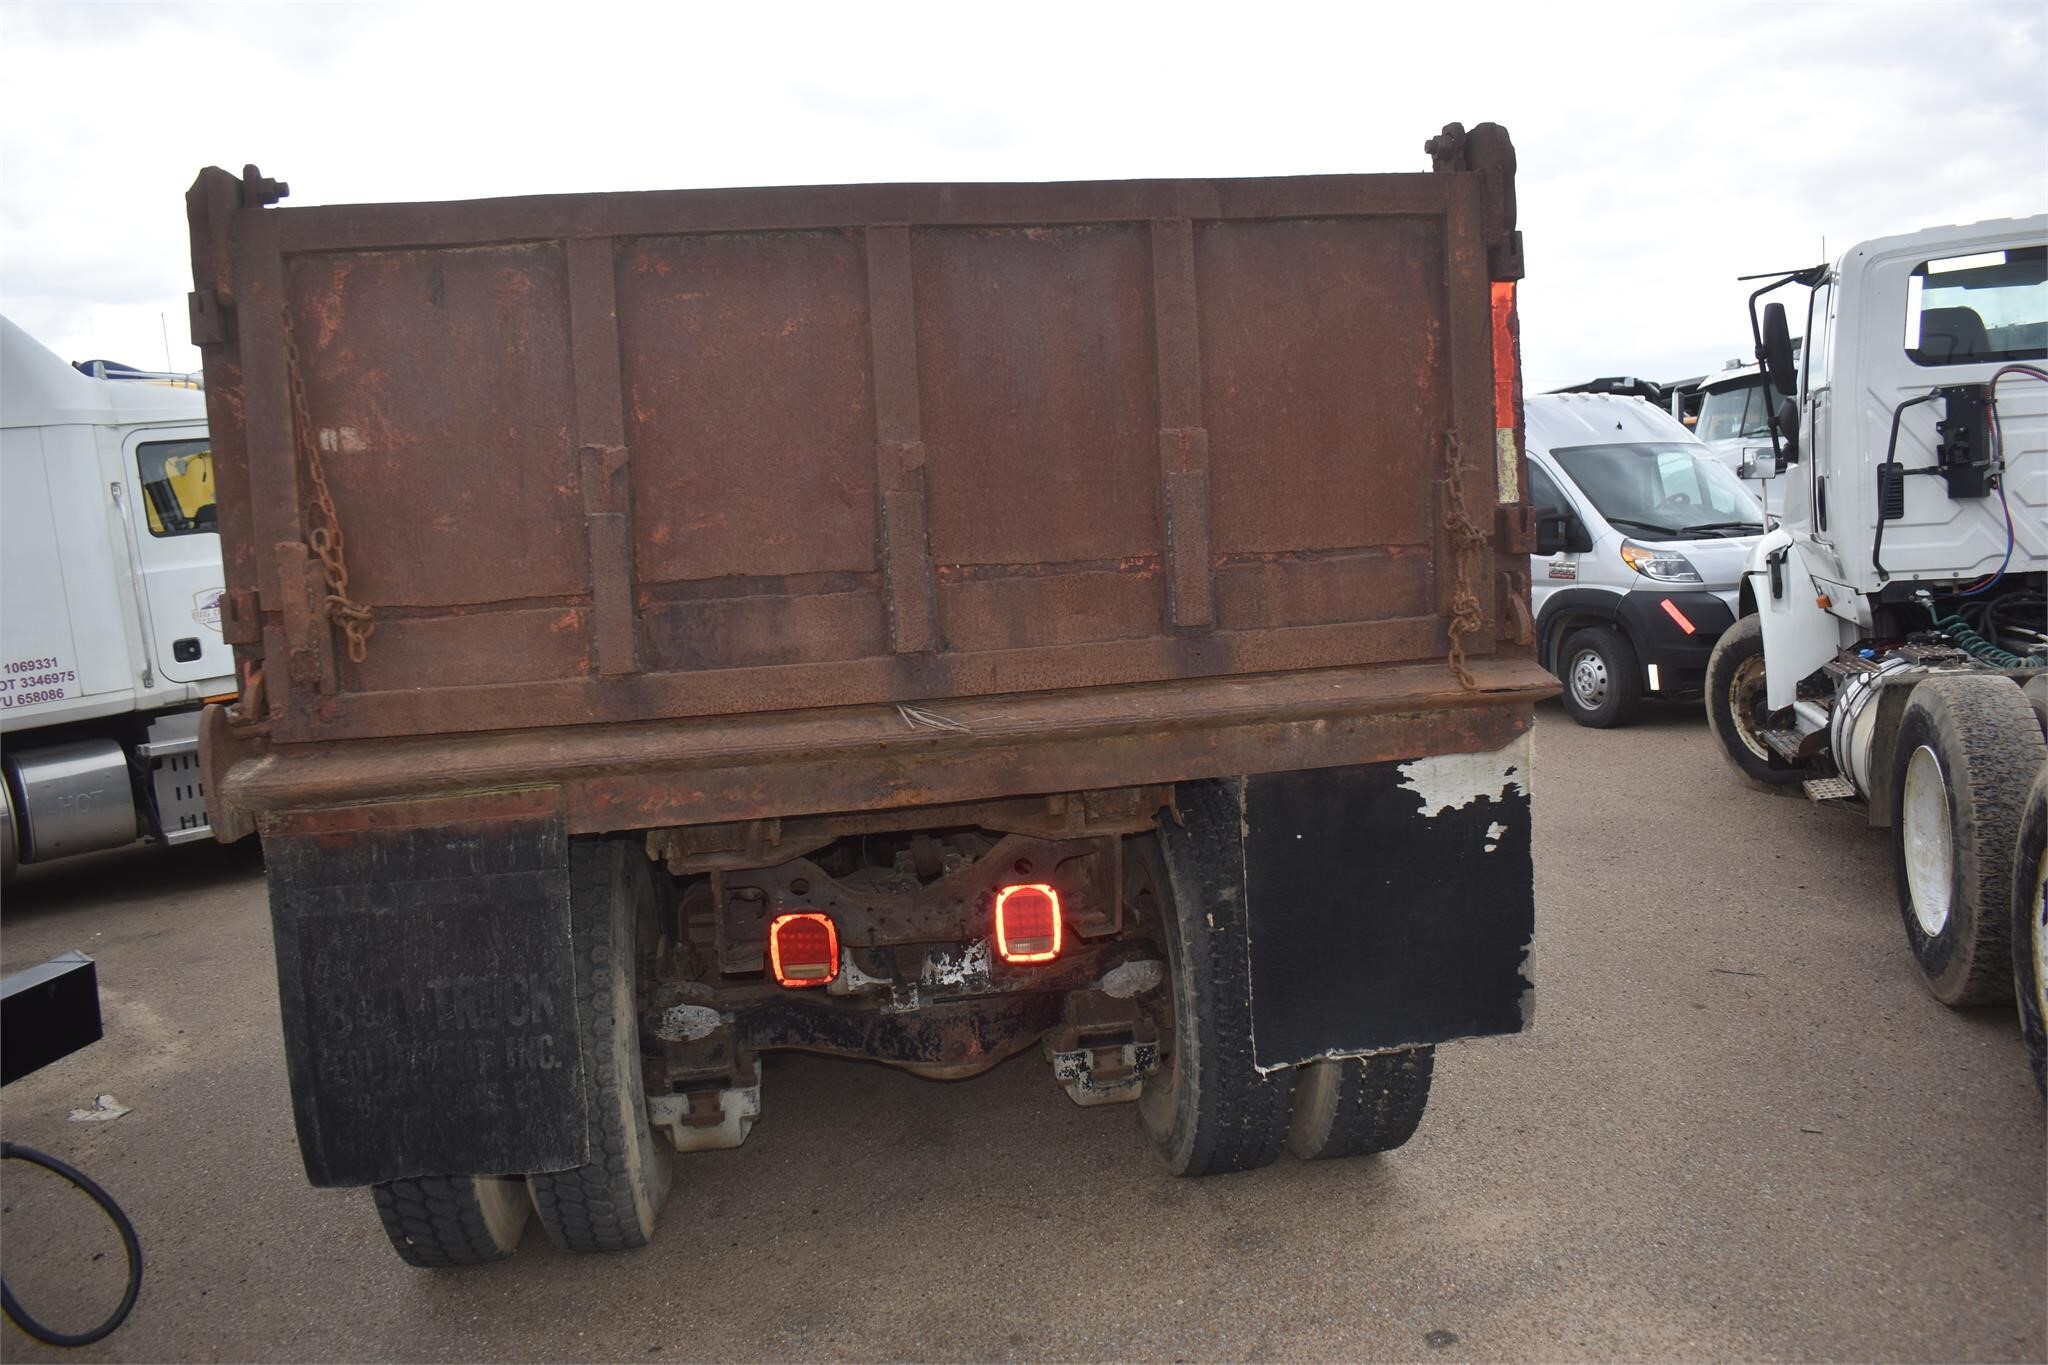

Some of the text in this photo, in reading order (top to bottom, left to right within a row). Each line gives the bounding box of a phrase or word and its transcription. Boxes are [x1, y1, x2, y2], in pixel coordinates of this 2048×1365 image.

[4, 657, 58, 674] 1069331
[20, 670, 75, 688] 3346975
[17, 688, 64, 705] 658086
